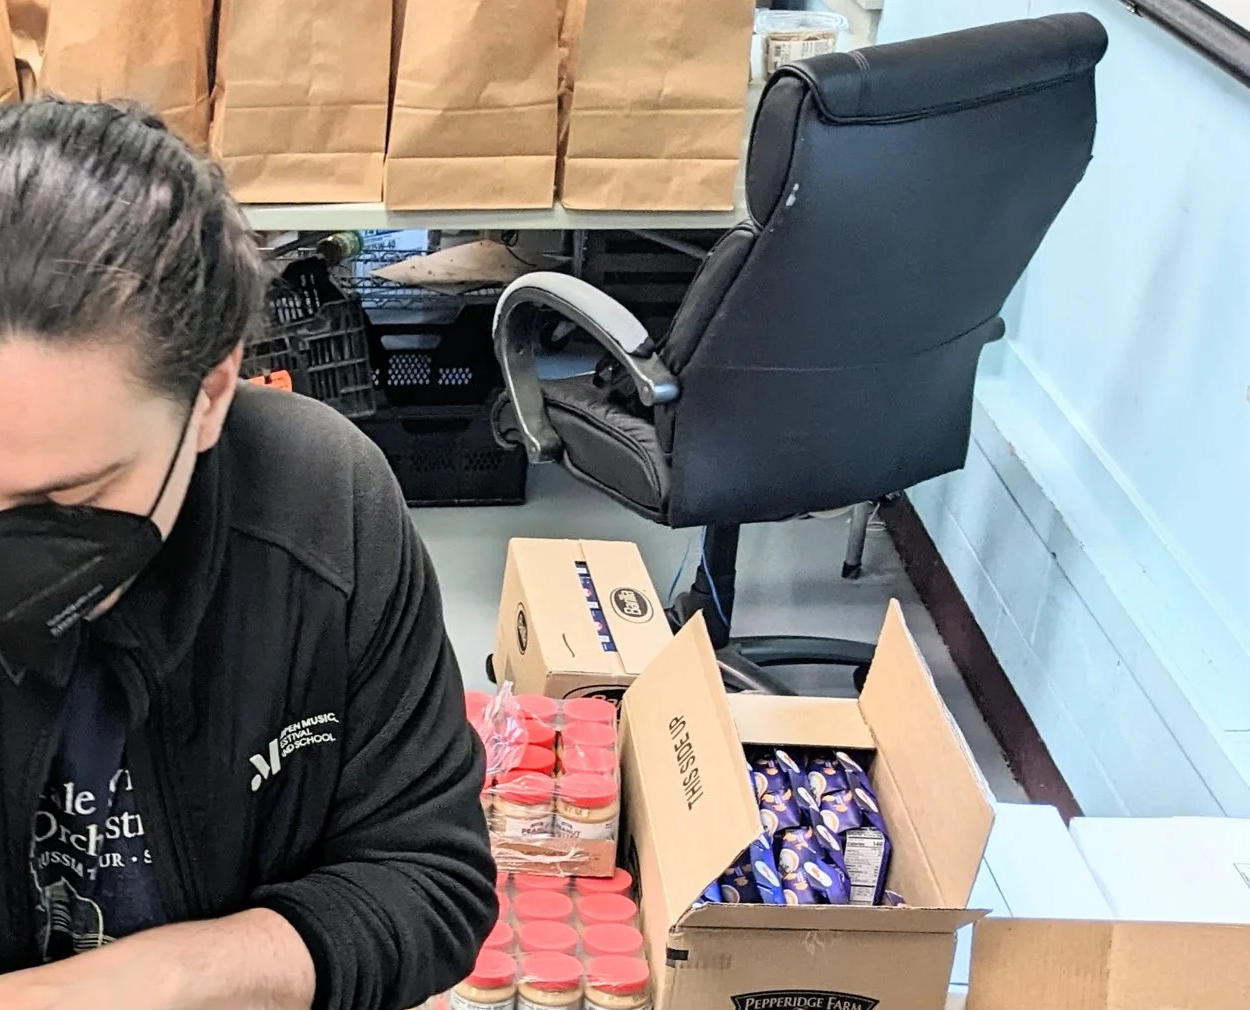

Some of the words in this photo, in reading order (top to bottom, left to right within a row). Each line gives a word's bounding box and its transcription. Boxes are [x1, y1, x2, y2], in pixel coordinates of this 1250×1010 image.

[294, 733, 336, 749] SCHOOL
[669, 714, 687, 741] UP
[674, 731, 696, 774] SIDE
[682, 767, 704, 811] THIS
